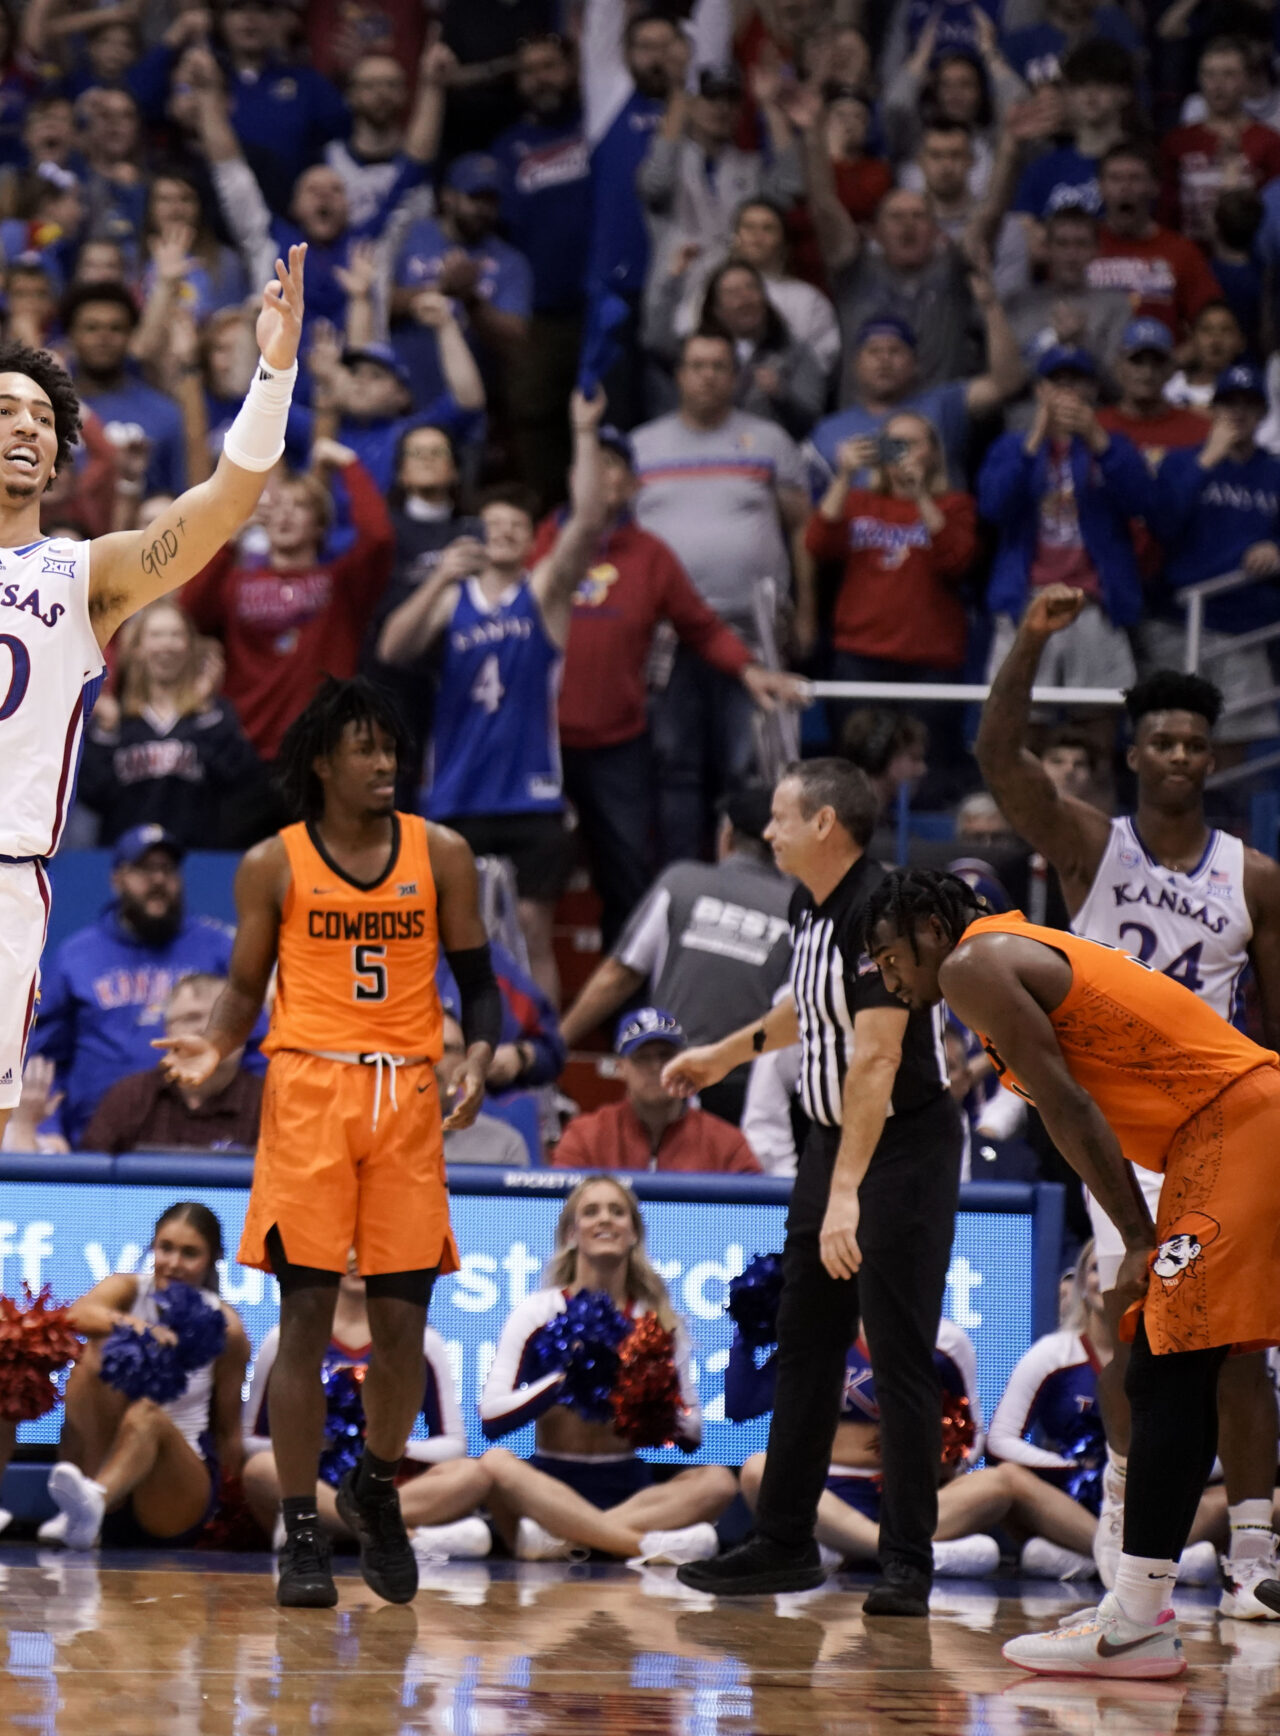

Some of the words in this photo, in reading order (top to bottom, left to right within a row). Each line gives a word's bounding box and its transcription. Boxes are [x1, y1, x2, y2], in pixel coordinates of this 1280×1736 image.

[141, 529, 178, 578] GOD
[473, 654, 505, 714] 4
[309, 910, 425, 940] COWBOYS
[692, 894, 791, 945] BEST
[1112, 884, 1230, 934] KANSAS
[354, 944, 388, 1003] 5
[1119, 921, 1204, 994] 24
[839, 1364, 883, 1421] K
